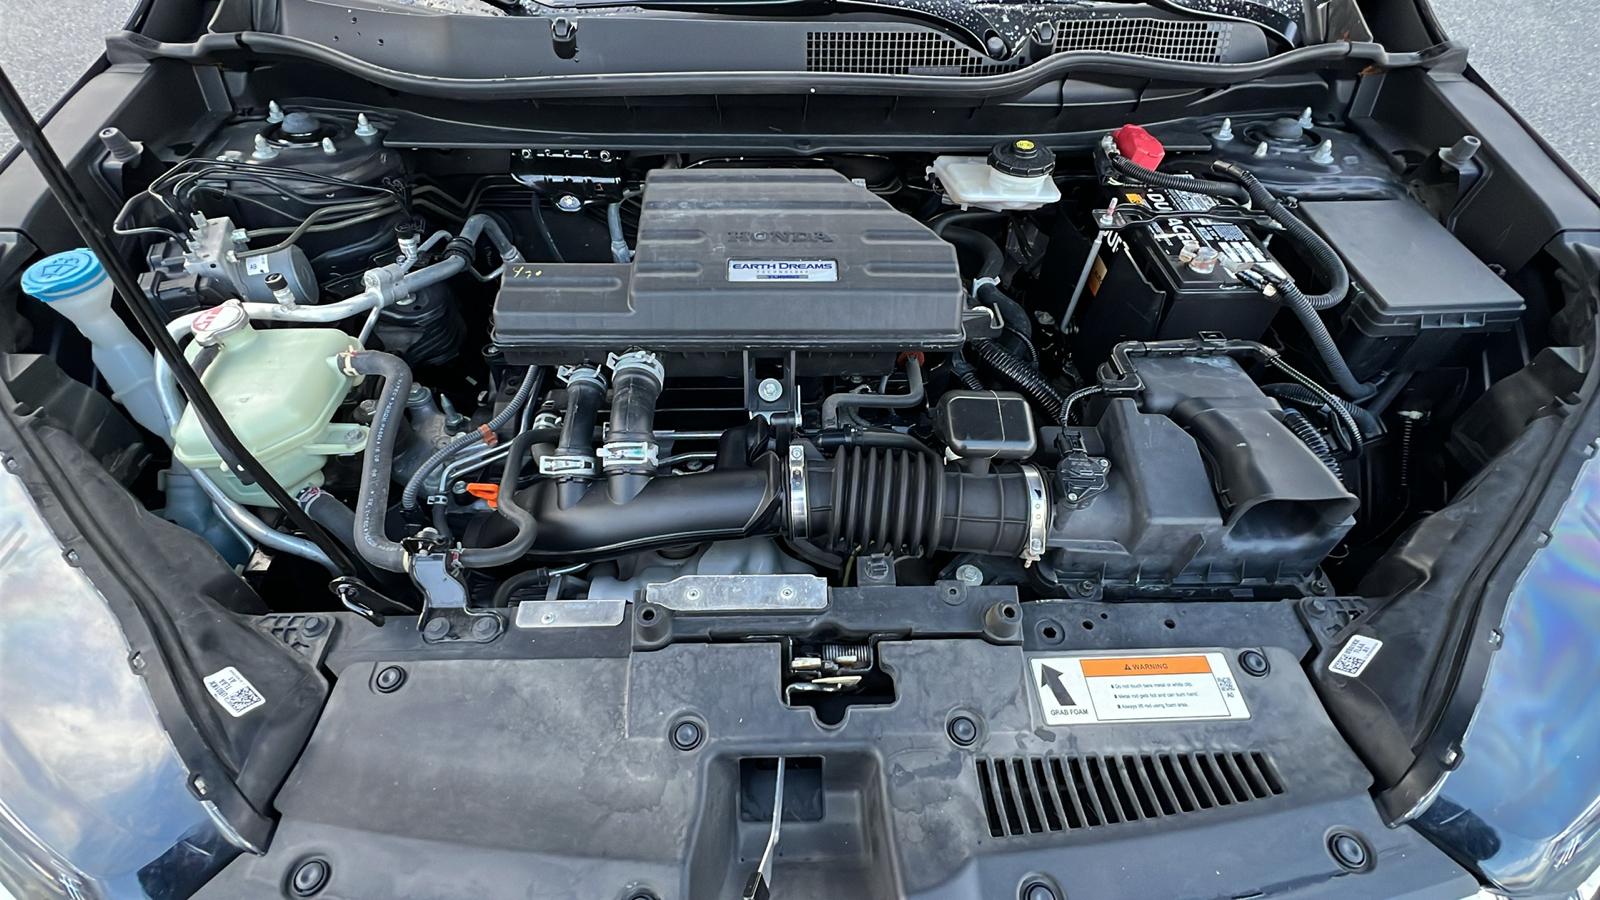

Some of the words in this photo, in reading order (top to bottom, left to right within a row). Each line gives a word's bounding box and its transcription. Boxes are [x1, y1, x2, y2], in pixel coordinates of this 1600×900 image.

[727, 231, 834, 243] HONDA
[778, 262, 833, 270] DREAMS
[1132, 662, 1169, 671] WARNING
